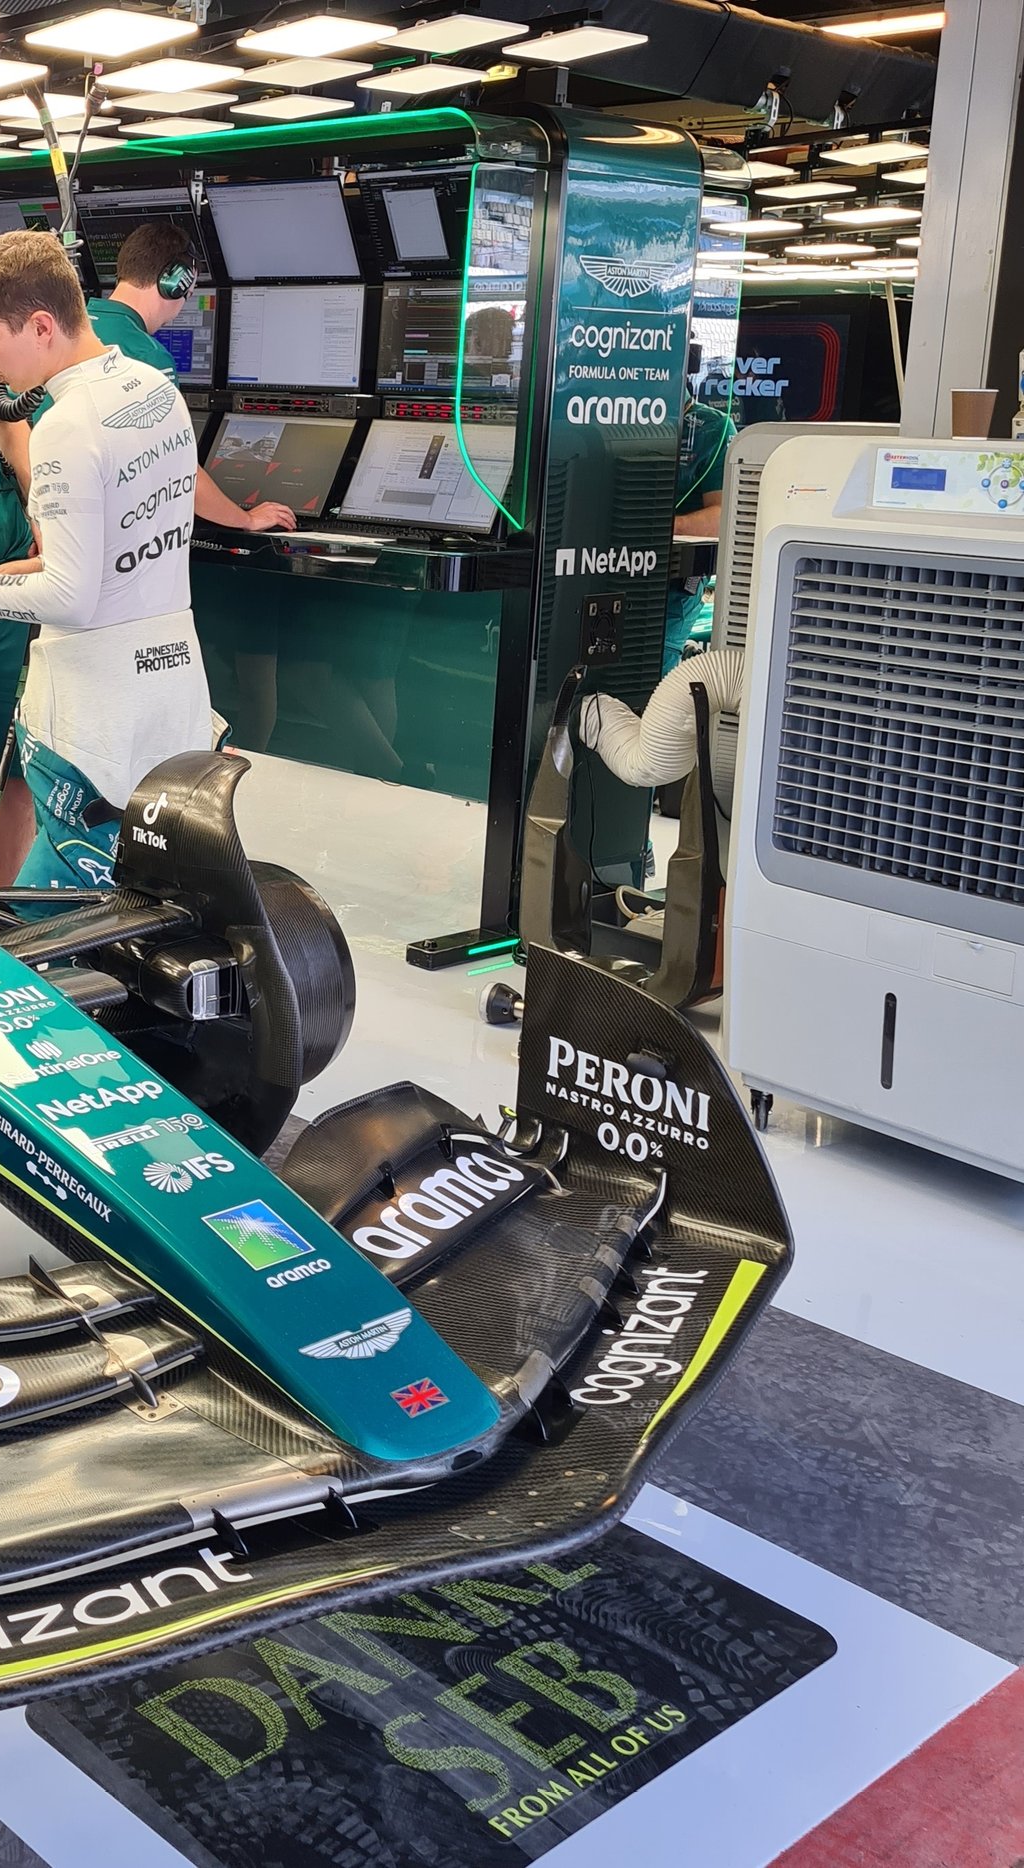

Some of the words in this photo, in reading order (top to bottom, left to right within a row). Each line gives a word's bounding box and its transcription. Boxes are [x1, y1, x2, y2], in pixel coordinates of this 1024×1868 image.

[571, 321, 673, 358] cognizant
[122, 377, 142, 393] BOSS
[568, 365, 616, 380] FORMULA
[645, 368, 670, 381] TEAM
[130, 405, 146, 418] ASTON
[145, 394, 166, 411] MARTIN
[566, 395, 667, 426] aramco
[117, 443, 160, 488] ASTON
[163, 427, 194, 457] MAR
[120, 472, 197, 530] cognizan
[580, 546, 657, 577] NetApp
[134, 641, 189, 661] ALPINESTARS
[136, 651, 191, 674] PROTECTS
[132, 826, 168, 852] TikTok
[36, 1079, 164, 1121] NetApp
[547, 1036, 711, 1132] PERONI
[545, 1082, 615, 1116] NASTRO
[619, 1111, 710, 1150] AZZURRO
[91, 1124, 161, 1152] IRELLI
[596, 1121, 664, 1163] 0.0%
[181, 1152, 235, 1180] IFS
[352, 1150, 525, 1260] aramco
[266, 1257, 331, 1289] aramco
[338, 1334, 362, 1349] ASTON
[361, 1323, 388, 1341] MARTIN
[569, 1266, 709, 1406] cognizant
[383, 1639, 640, 1813] SEB
[487, 1779, 574, 1838] FROM
[566, 1752, 619, 1788] ALL
[610, 1725, 651, 1756] OF
[644, 1704, 687, 1732] US
